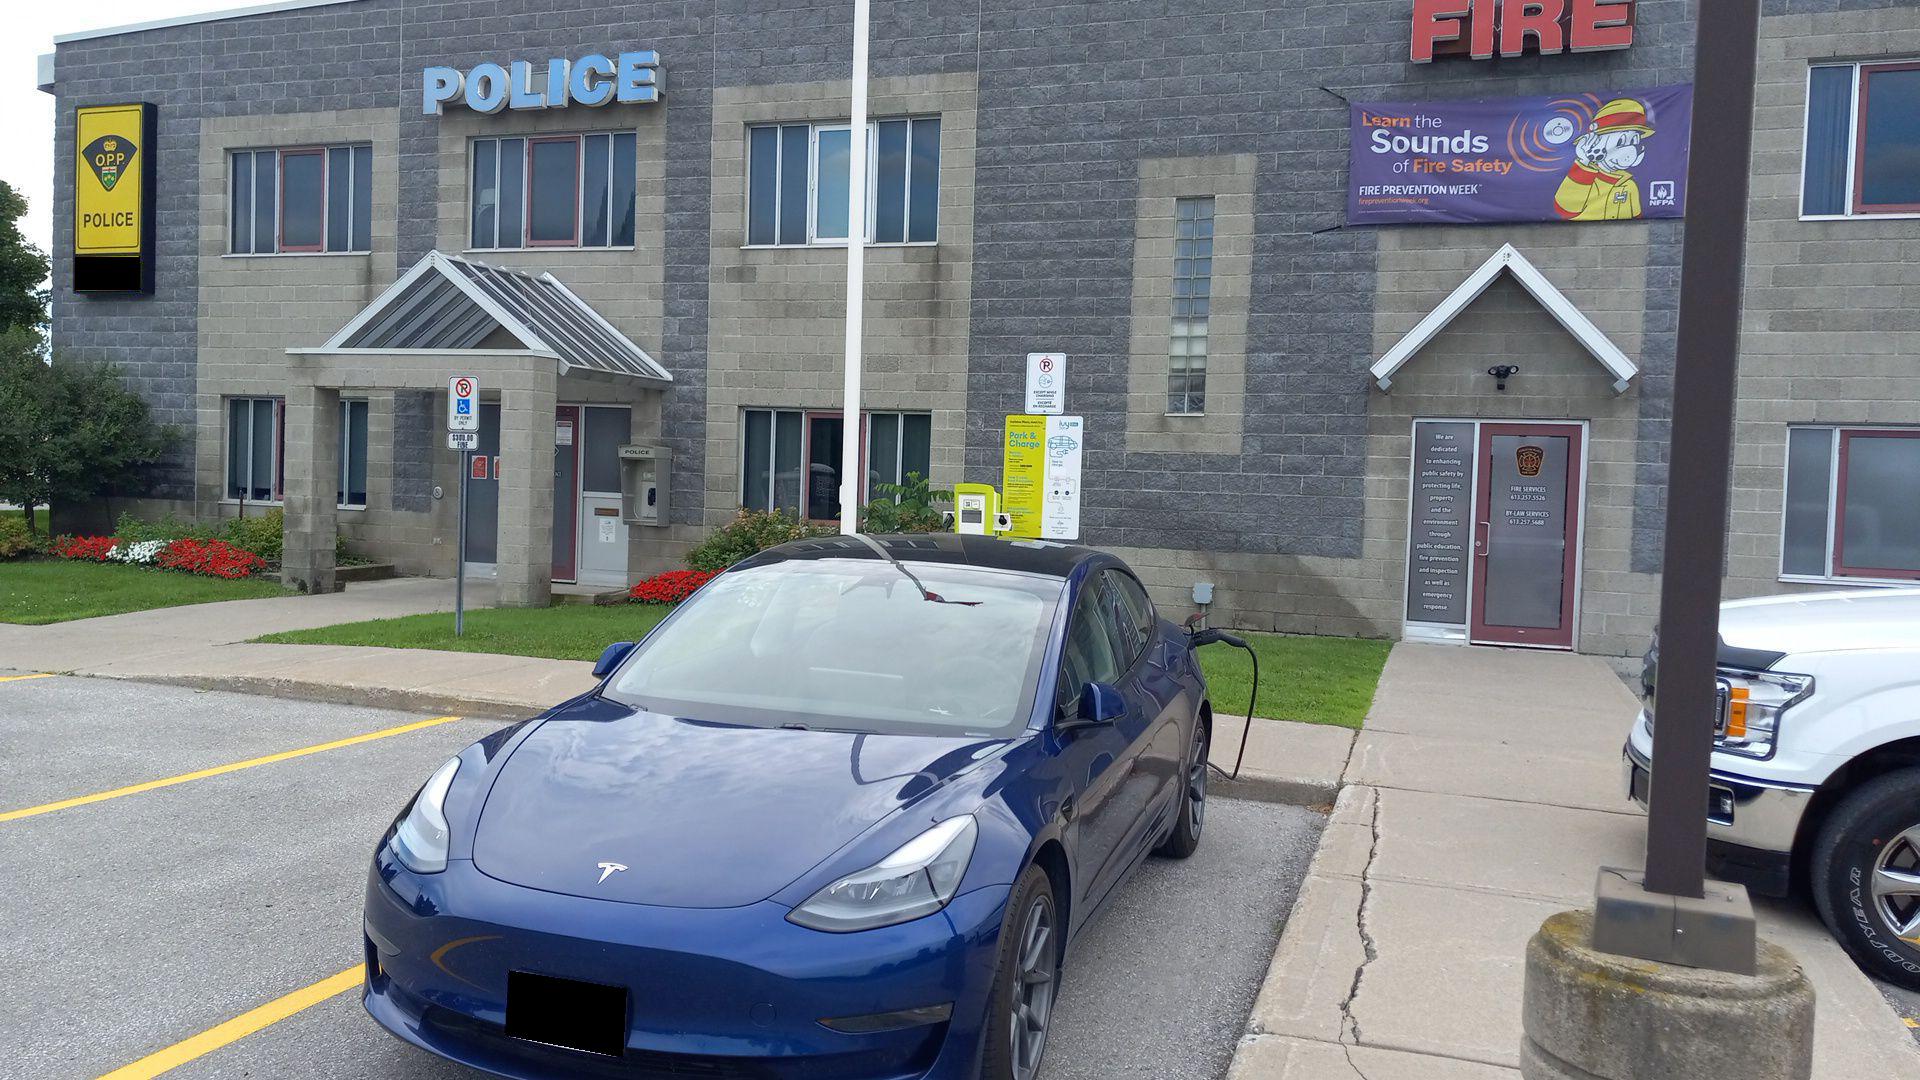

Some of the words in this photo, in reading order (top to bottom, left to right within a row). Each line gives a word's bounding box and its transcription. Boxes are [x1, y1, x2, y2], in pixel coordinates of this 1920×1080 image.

[1411, 0, 1633, 64] FIRE
[423, 50, 660, 116] POLICE
[1362, 111, 1411, 128] Learn
[1414, 114, 1442, 128] the
[1370, 128, 1489, 153] Sounds
[1392, 158, 1410, 174] of
[1413, 158, 1446, 173] Fire
[1451, 158, 1512, 175] Safety
[1359, 185, 1380, 196] FIRE
[1382, 184, 1448, 195] PREVENTION
[83, 212, 134, 228] POLICE
[1009, 440, 1040, 449] Charge
